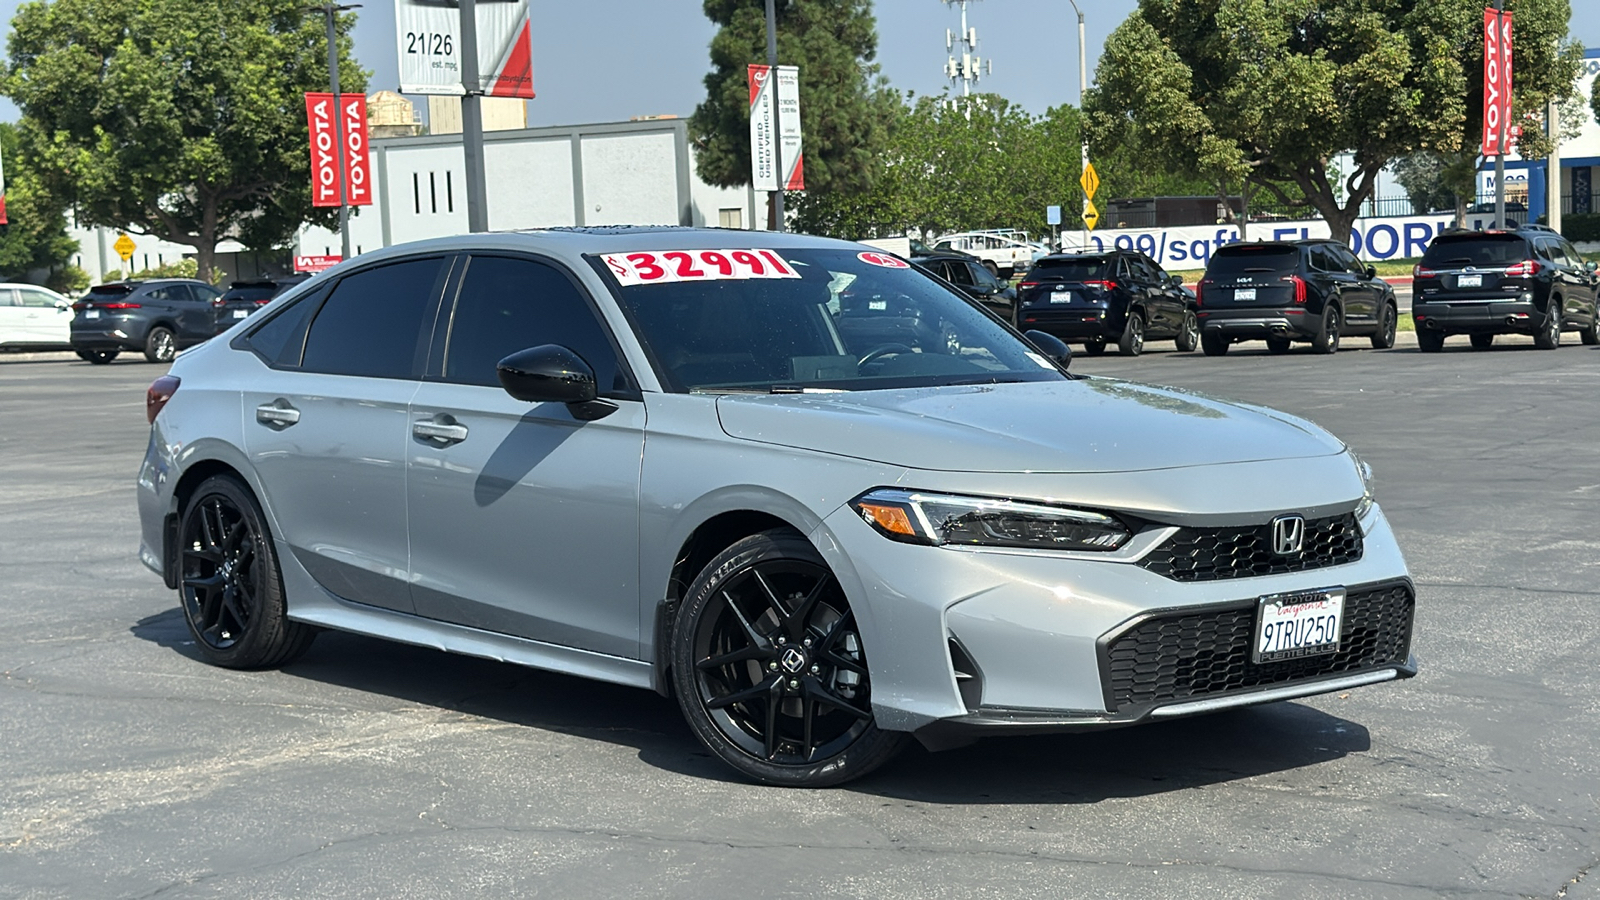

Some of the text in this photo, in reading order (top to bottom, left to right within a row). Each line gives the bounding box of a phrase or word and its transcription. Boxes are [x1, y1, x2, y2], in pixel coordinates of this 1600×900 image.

[406, 32, 453, 56] 21/26
[431, 61, 443, 69] est.
[1486, 19, 1499, 148] TOYOTA
[762, 94, 771, 147] VEHICLES
[313, 100, 335, 201] TOYOTA
[346, 101, 366, 200] TOYOTA
[757, 122, 765, 179] CERTIFIED
[1091, 229, 1241, 267] 99/sqf
[1277, 600, 1328, 618] California
[1284, 592, 1327, 605] TOYOTA
[1260, 643, 1335, 661] PUENTE HILLS
[1262, 614, 1336, 652] 9TRU250
